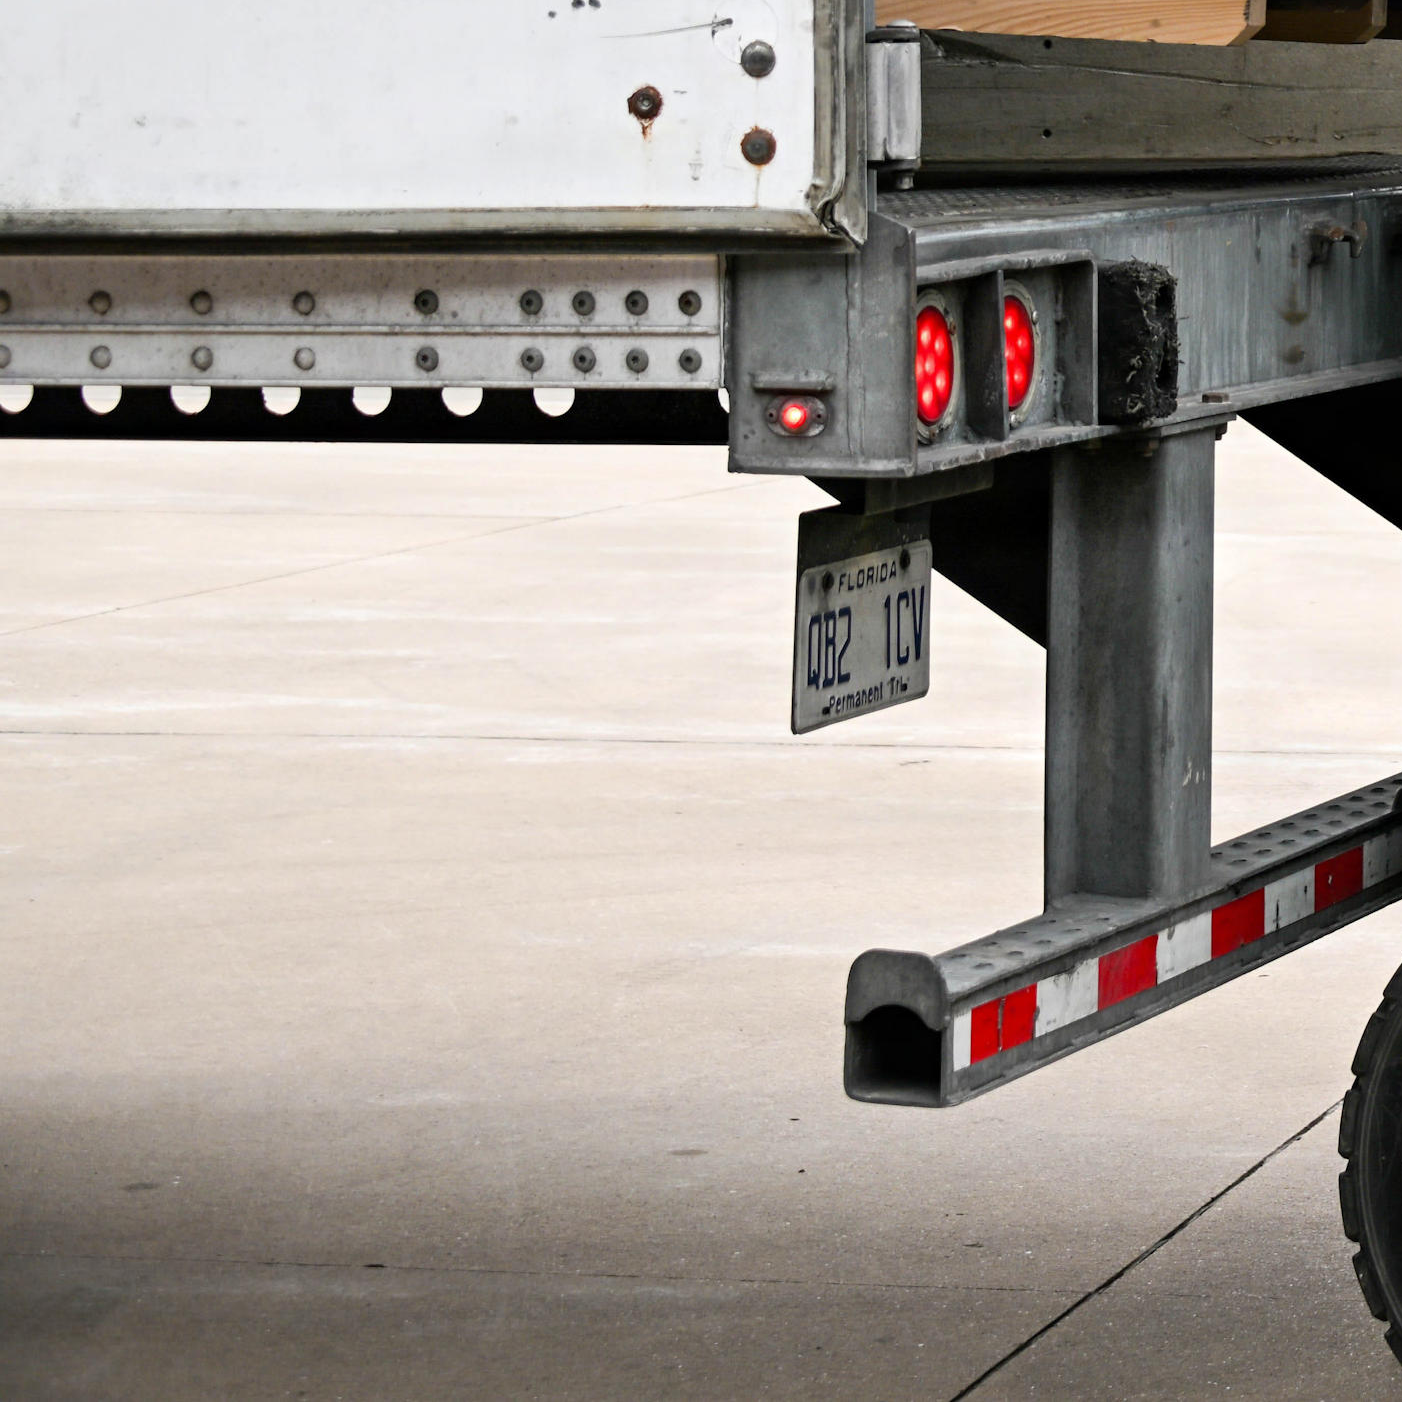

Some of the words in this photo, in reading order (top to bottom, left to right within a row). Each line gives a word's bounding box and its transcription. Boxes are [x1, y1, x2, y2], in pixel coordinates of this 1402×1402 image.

[838, 560, 897, 593] FLORIDA
[807, 606, 852, 691] QB2
[884, 585, 925, 671] 1CV
[829, 681, 884, 715] Permanent
